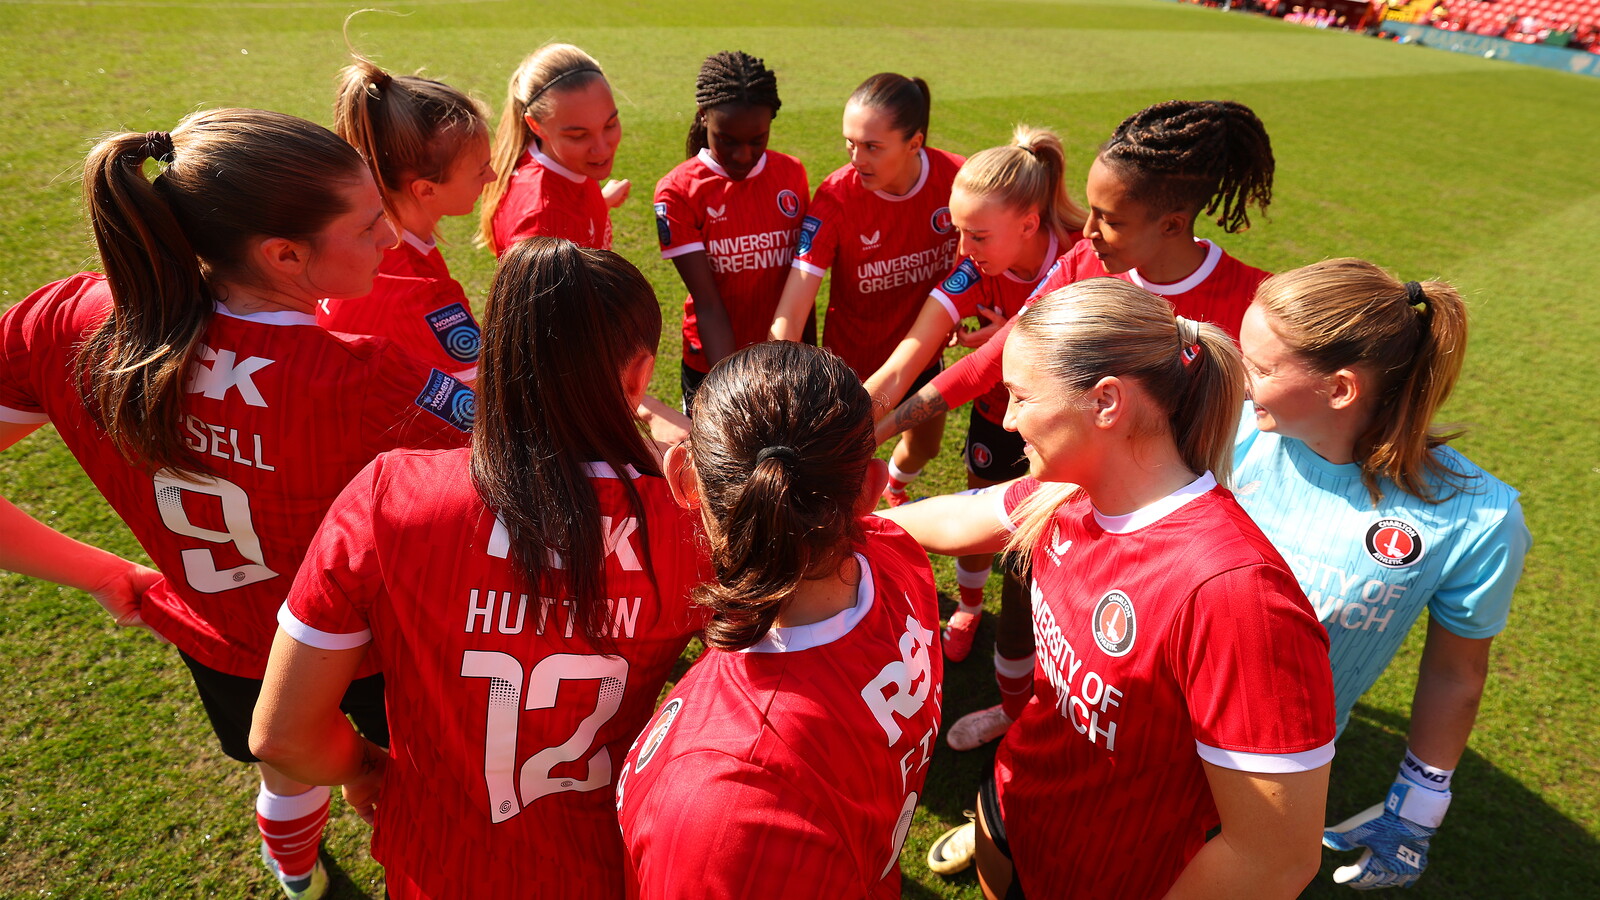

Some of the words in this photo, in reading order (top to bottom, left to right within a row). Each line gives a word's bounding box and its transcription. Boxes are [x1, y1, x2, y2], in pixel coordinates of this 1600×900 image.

[708, 247, 796, 273] GREENWIC
[858, 246, 940, 279] UNIVERSITY
[941, 238, 957, 254] OF
[859, 253, 957, 293] GREENWICH
[433, 312, 466, 328] WOMEN'S
[430, 376, 451, 407] WOMEN'S
[181, 414, 275, 472] SELL
[153, 466, 280, 594] 9
[1378, 520, 1418, 538] CHARLTON
[1372, 552, 1404, 565] ATHLETIC
[1361, 579, 1407, 606] OF
[1081, 671, 1123, 713] OF
[460, 650, 630, 824] 12
